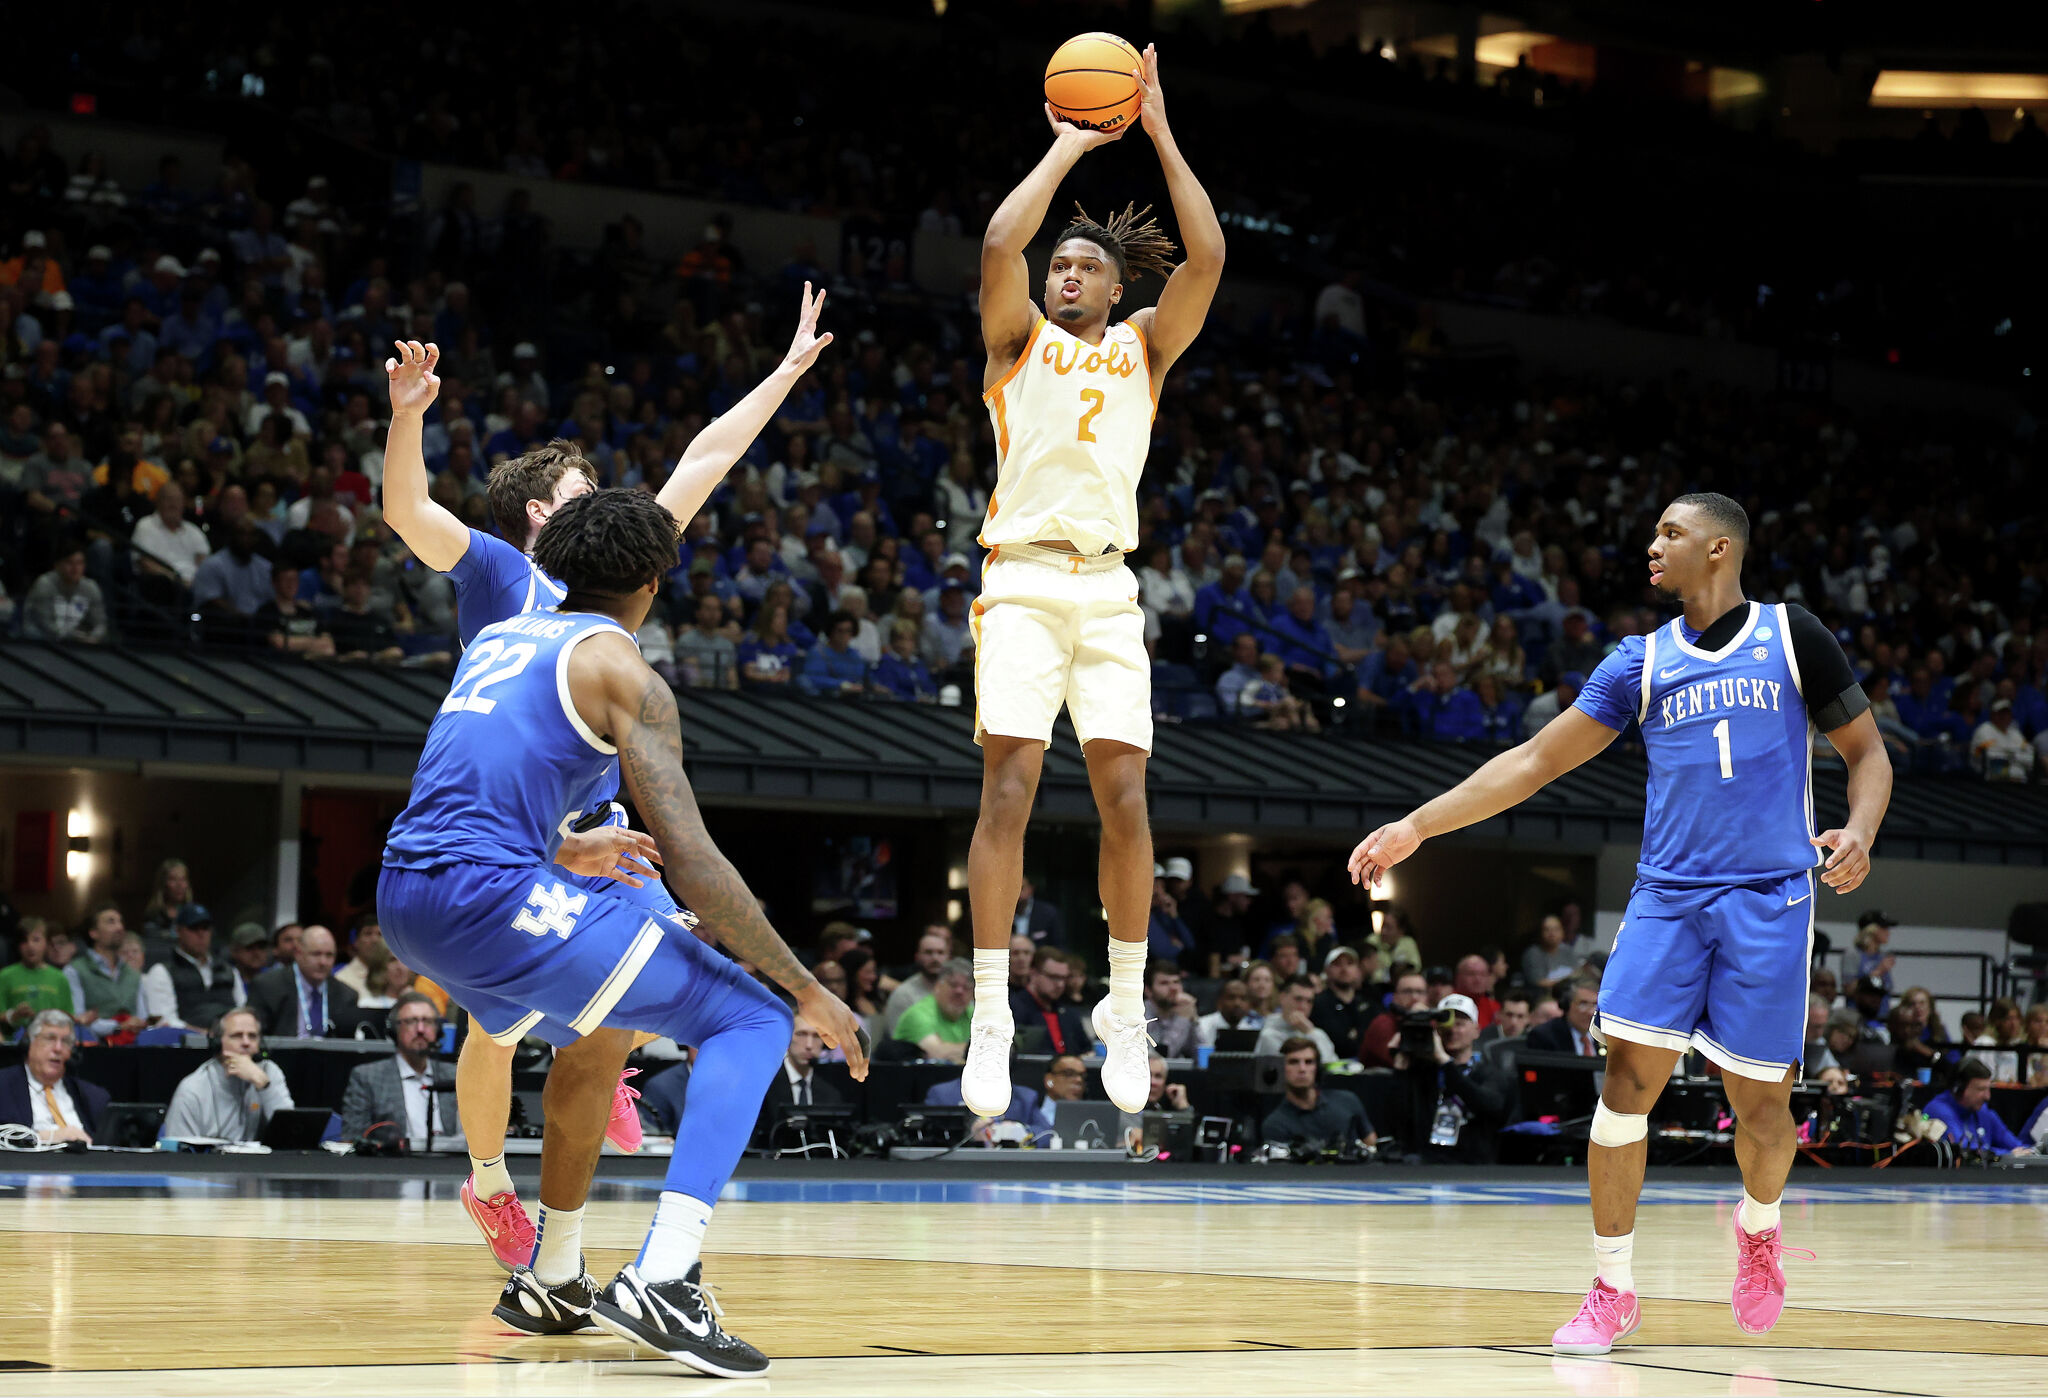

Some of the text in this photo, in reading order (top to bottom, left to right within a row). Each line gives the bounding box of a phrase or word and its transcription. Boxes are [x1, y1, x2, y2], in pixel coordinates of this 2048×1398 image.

[1043, 340, 1138, 378] Vols
[1078, 387, 1105, 443] 2
[1068, 556, 1086, 573] T
[440, 639, 537, 715] 22
[1662, 677, 1781, 729] KENTUCKY
[1712, 719, 1734, 779] 1
[511, 882, 589, 940] UK
